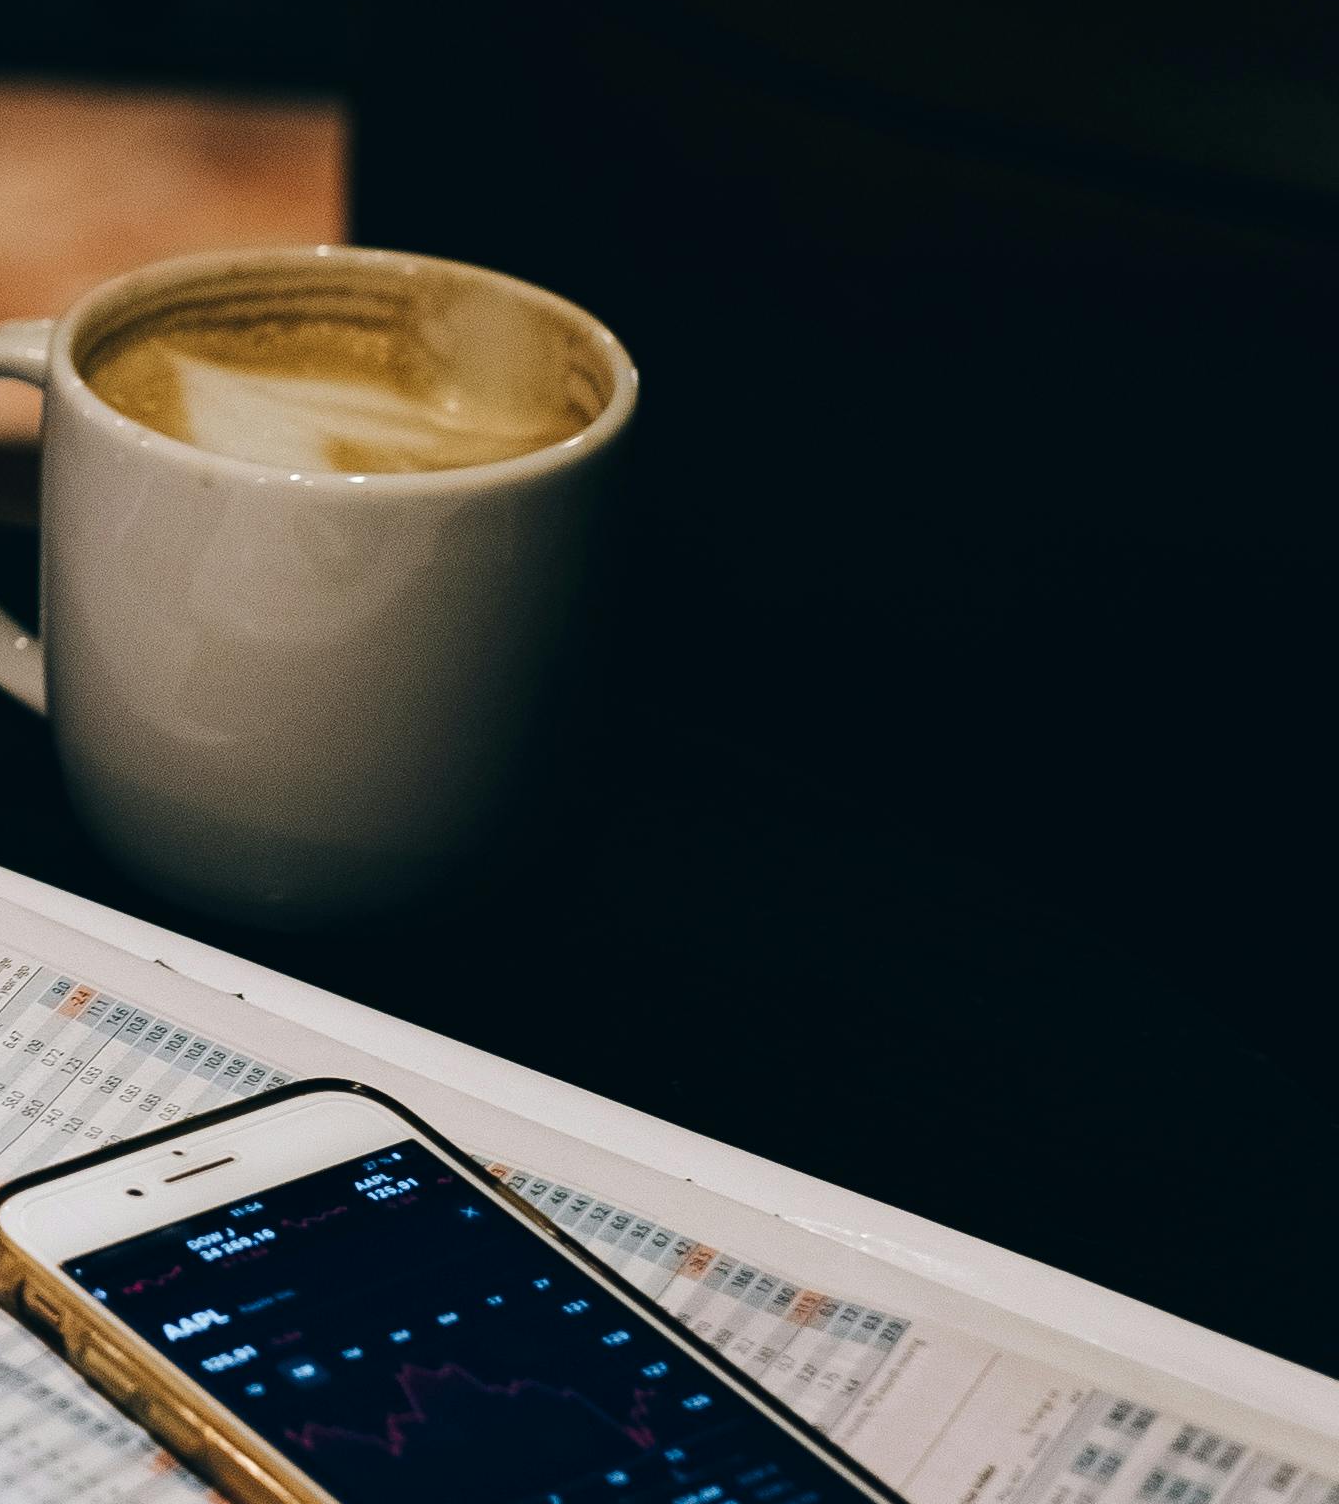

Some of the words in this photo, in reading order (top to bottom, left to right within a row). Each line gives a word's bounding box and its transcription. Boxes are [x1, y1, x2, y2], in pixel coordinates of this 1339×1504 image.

[354, 1173, 393, 1191] AAPL
[186, 1231, 223, 1251] DOW
[162, 1307, 231, 1342] AAPL
